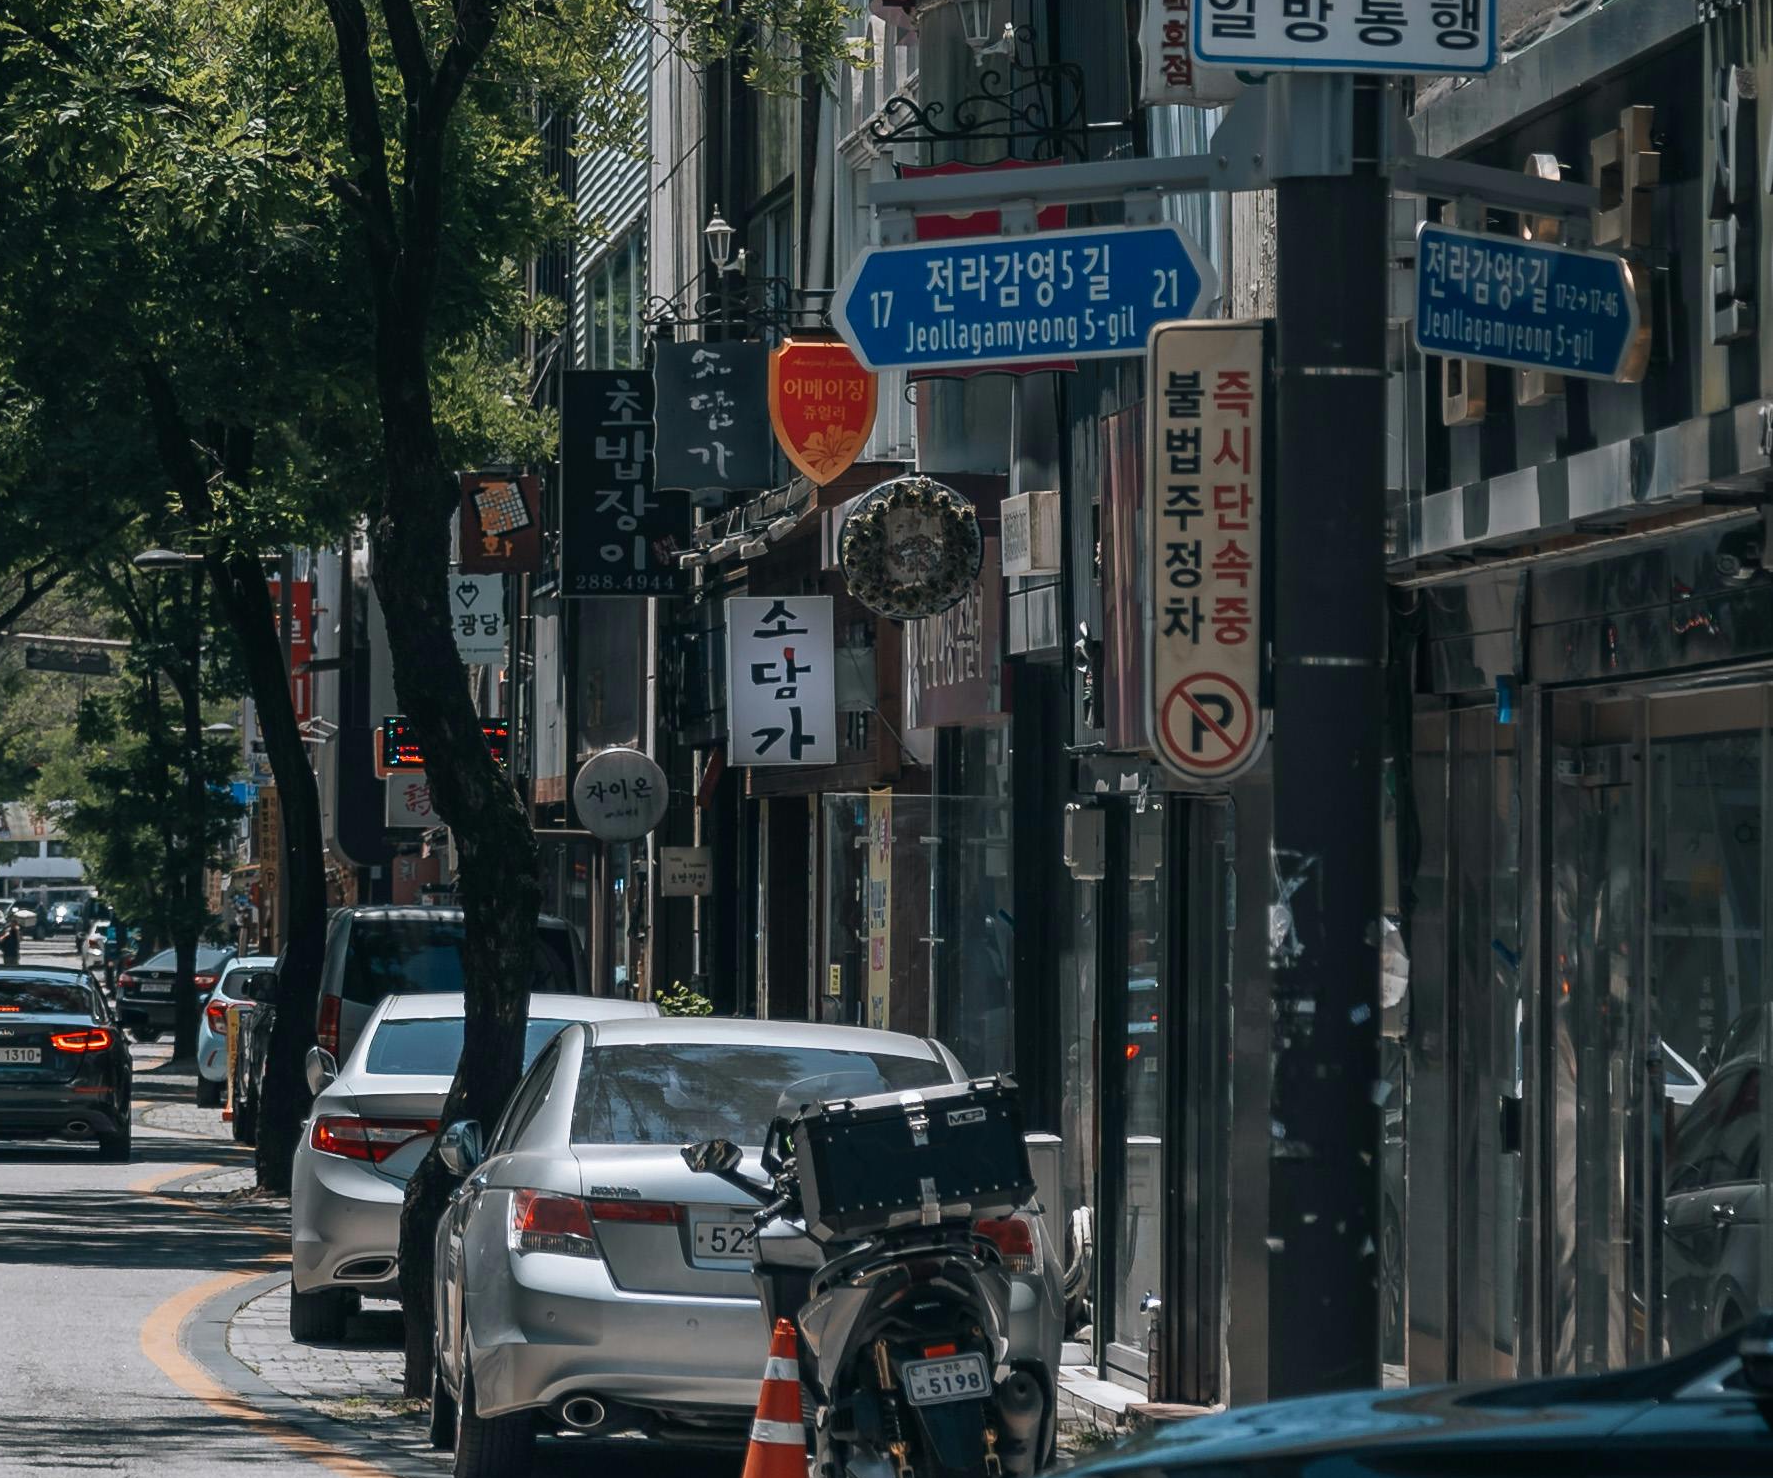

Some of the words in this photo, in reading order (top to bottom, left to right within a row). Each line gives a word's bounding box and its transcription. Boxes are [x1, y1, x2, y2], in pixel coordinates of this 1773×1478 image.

[869, 290, 895, 329] 17
[926, 244, 1110, 313] 전라감영5길
[1152, 269, 1178, 309] 21
[1426, 241, 1549, 314] 전라감영5길
[904, 316, 1078, 355] Jeollagamyeong
[1084, 305, 1136, 345] 5-gil
[1423, 305, 1552, 361] Jeollagamyeong
[1555, 324, 1594, 365] 5-gil
[783, 379, 865, 401] 어메이징
[803, 405, 846, 421] 쥬얼리
[1163, 370, 1205, 645] 불법주정차
[1211, 370, 1254, 646] 즉시단속중
[453, 613, 500, 636] 광당
[751, 600, 815, 761] 소담가
[587, 777, 652, 803] 자이온
[4, 1049, 35, 1061] 1310
[930, 1372, 980, 1395] 5198
